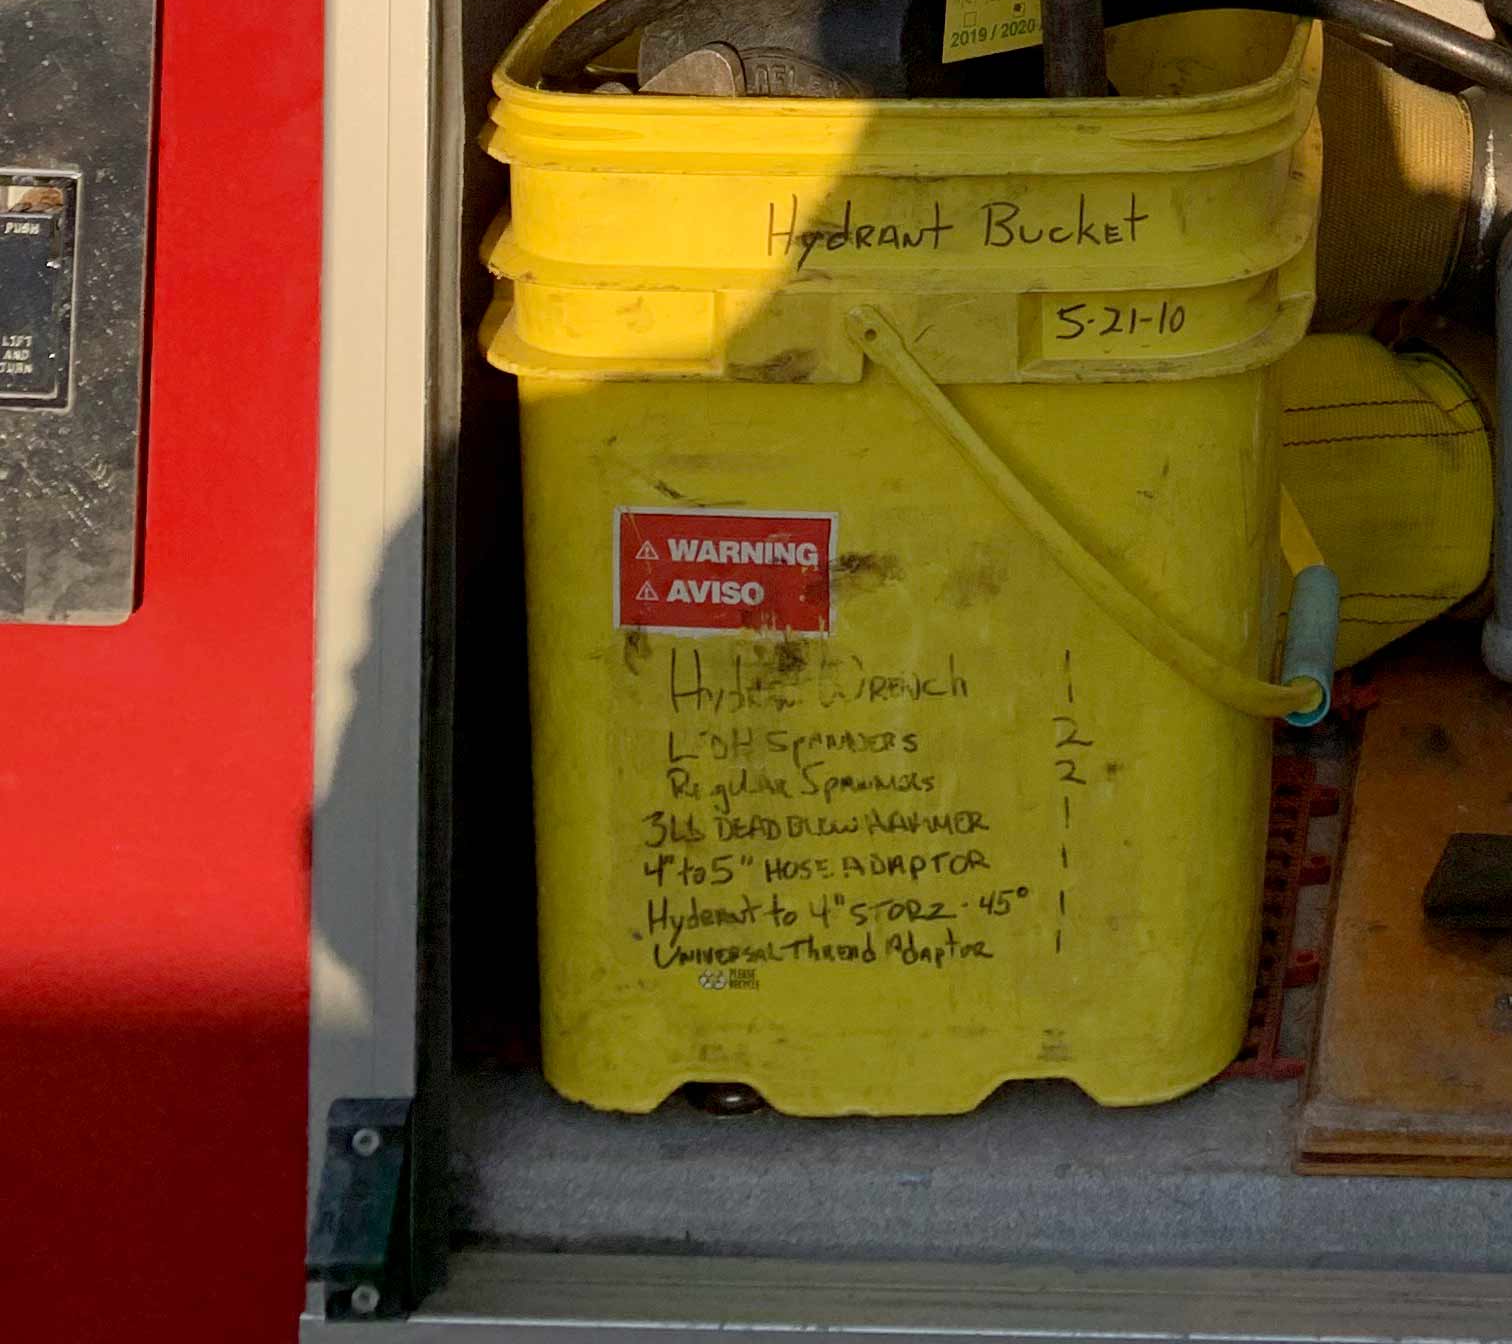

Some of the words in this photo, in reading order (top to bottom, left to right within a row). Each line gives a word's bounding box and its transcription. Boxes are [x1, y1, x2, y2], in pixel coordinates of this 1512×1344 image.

[950, 26, 988, 48] 2019
[1000, 18, 1036, 39] 2020
[4, 222, 40, 235] PUSH
[1055, 301, 1186, 340] 5-21-10
[2, 349, 30, 361] AND
[667, 538, 819, 567] WARNING
[666, 580, 765, 606] AVISO
[1052, 716, 1094, 749] 2
[1055, 759, 1087, 785] 2
[714, 812, 782, 841] DEAD
[765, 858, 829, 884] HOSE
[772, 895, 799, 929] to
[849, 900, 958, 928] STORZ
